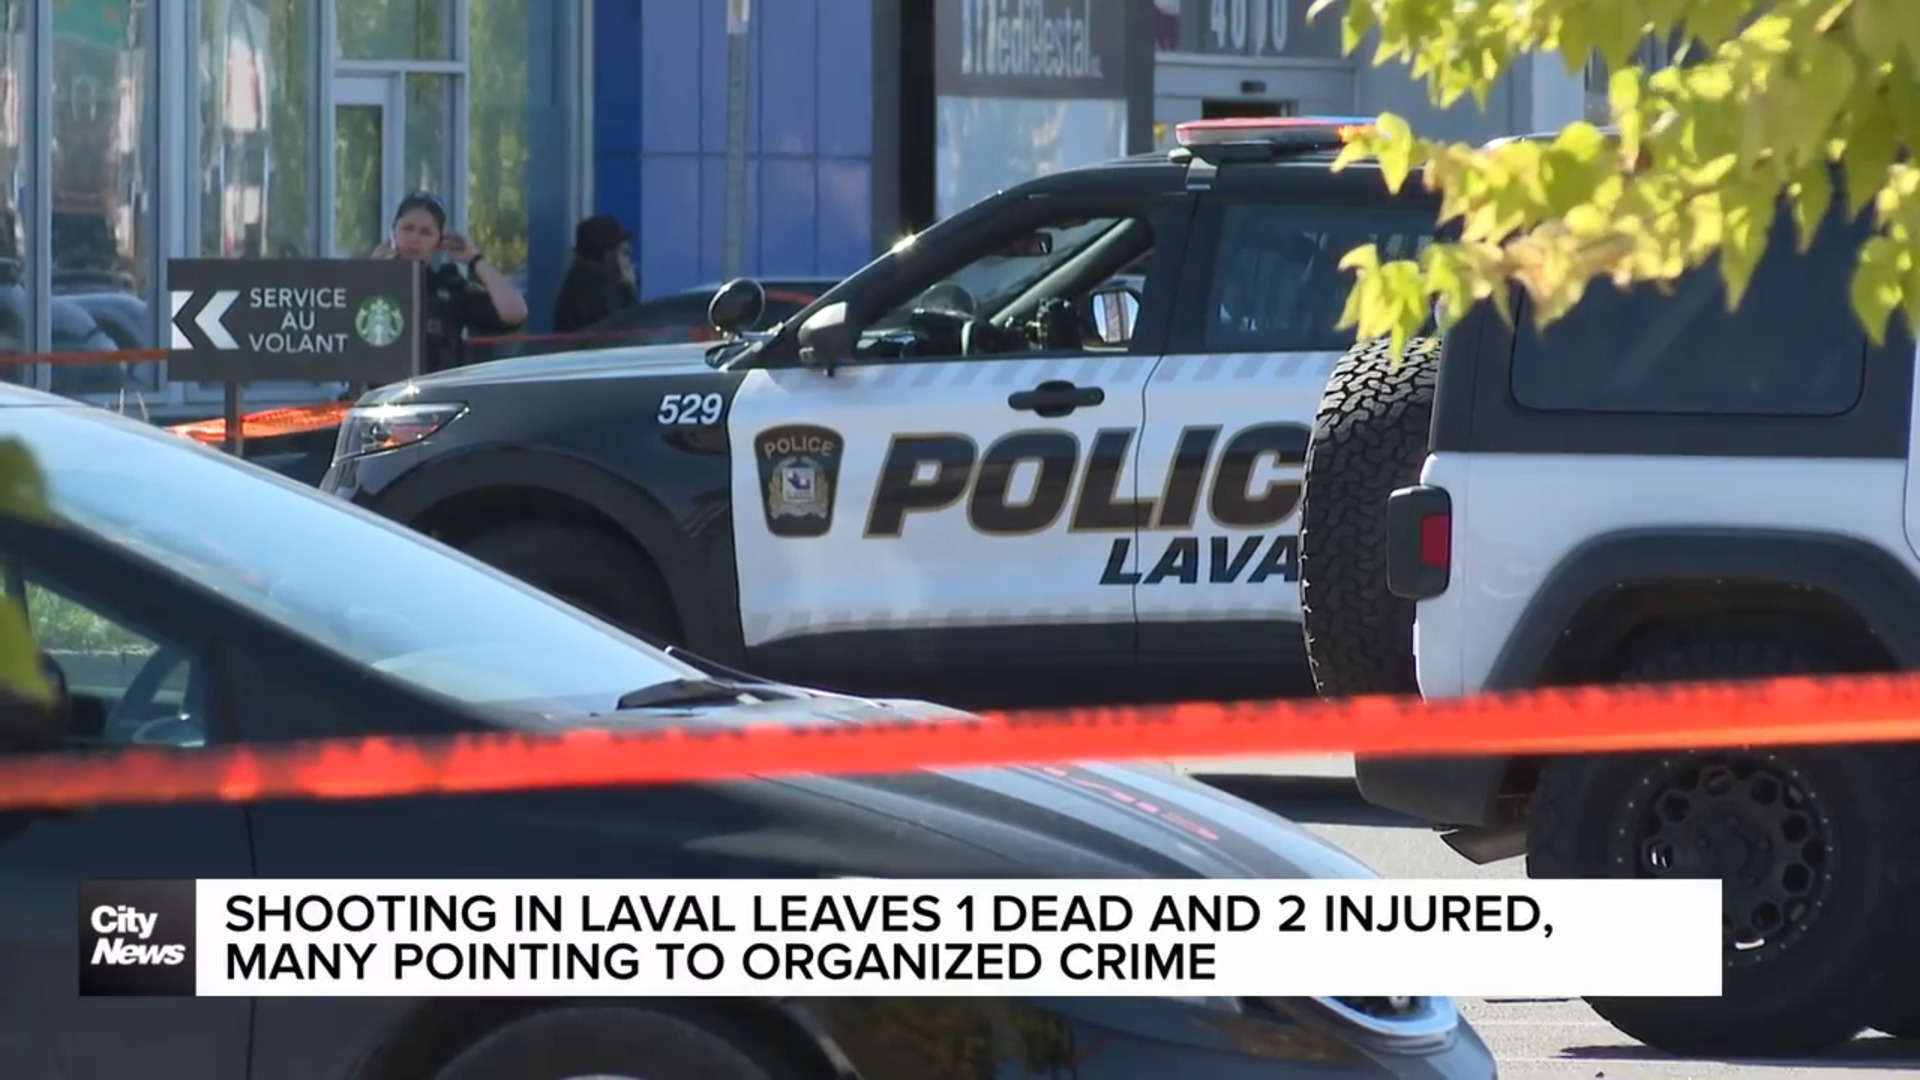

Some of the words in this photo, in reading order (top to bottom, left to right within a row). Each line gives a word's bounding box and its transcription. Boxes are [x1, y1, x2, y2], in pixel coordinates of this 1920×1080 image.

[250, 287, 346, 308] SERVICE
[281, 310, 315, 331] AU
[248, 333, 348, 353] VOLANT
[657, 392, 723, 425] 529
[764, 435, 836, 459] POLICE
[863, 421, 1312, 538] POLIC
[1099, 535, 1300, 585] LAVA
